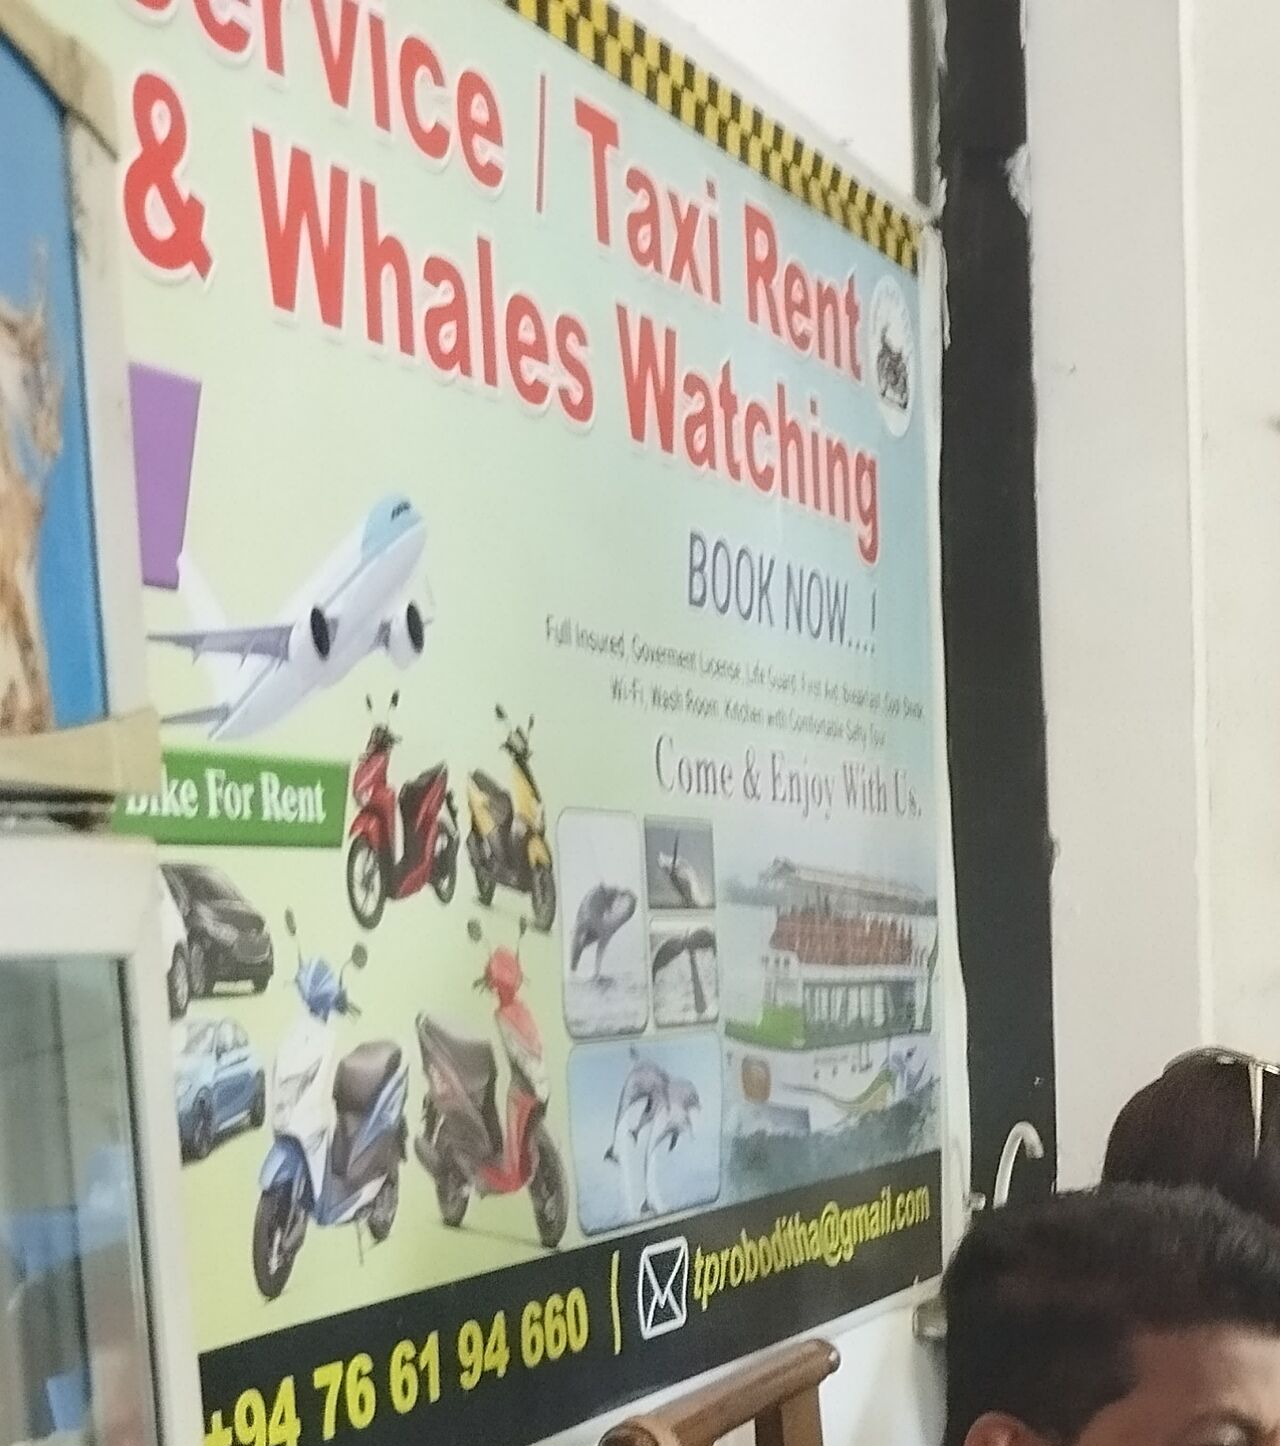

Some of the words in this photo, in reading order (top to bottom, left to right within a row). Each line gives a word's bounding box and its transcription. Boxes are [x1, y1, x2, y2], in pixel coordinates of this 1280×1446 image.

[130, 0, 504, 188] rvice
[574, 96, 721, 304] Taxi
[744, 203, 862, 382] Rent
[123, 72, 213, 282] &
[253, 128, 593, 423] Whales
[616, 303, 879, 564] Watching
[689, 530, 775, 627] BOOK
[205, 768, 254, 820] For
[260, 771, 327, 824] Rent
[655, 733, 734, 795] Come
[743, 745, 761, 801] &
[771, 748, 834, 820] Enjoy
[842, 760, 888, 816] With
[313, 1351, 377, 1441] 76
[389, 1330, 440, 1414] 61
[458, 1310, 510, 1391] 94
[520, 1286, 590, 1369] 660
[694, 1184, 931, 1312] tproboditha@gmail.com
